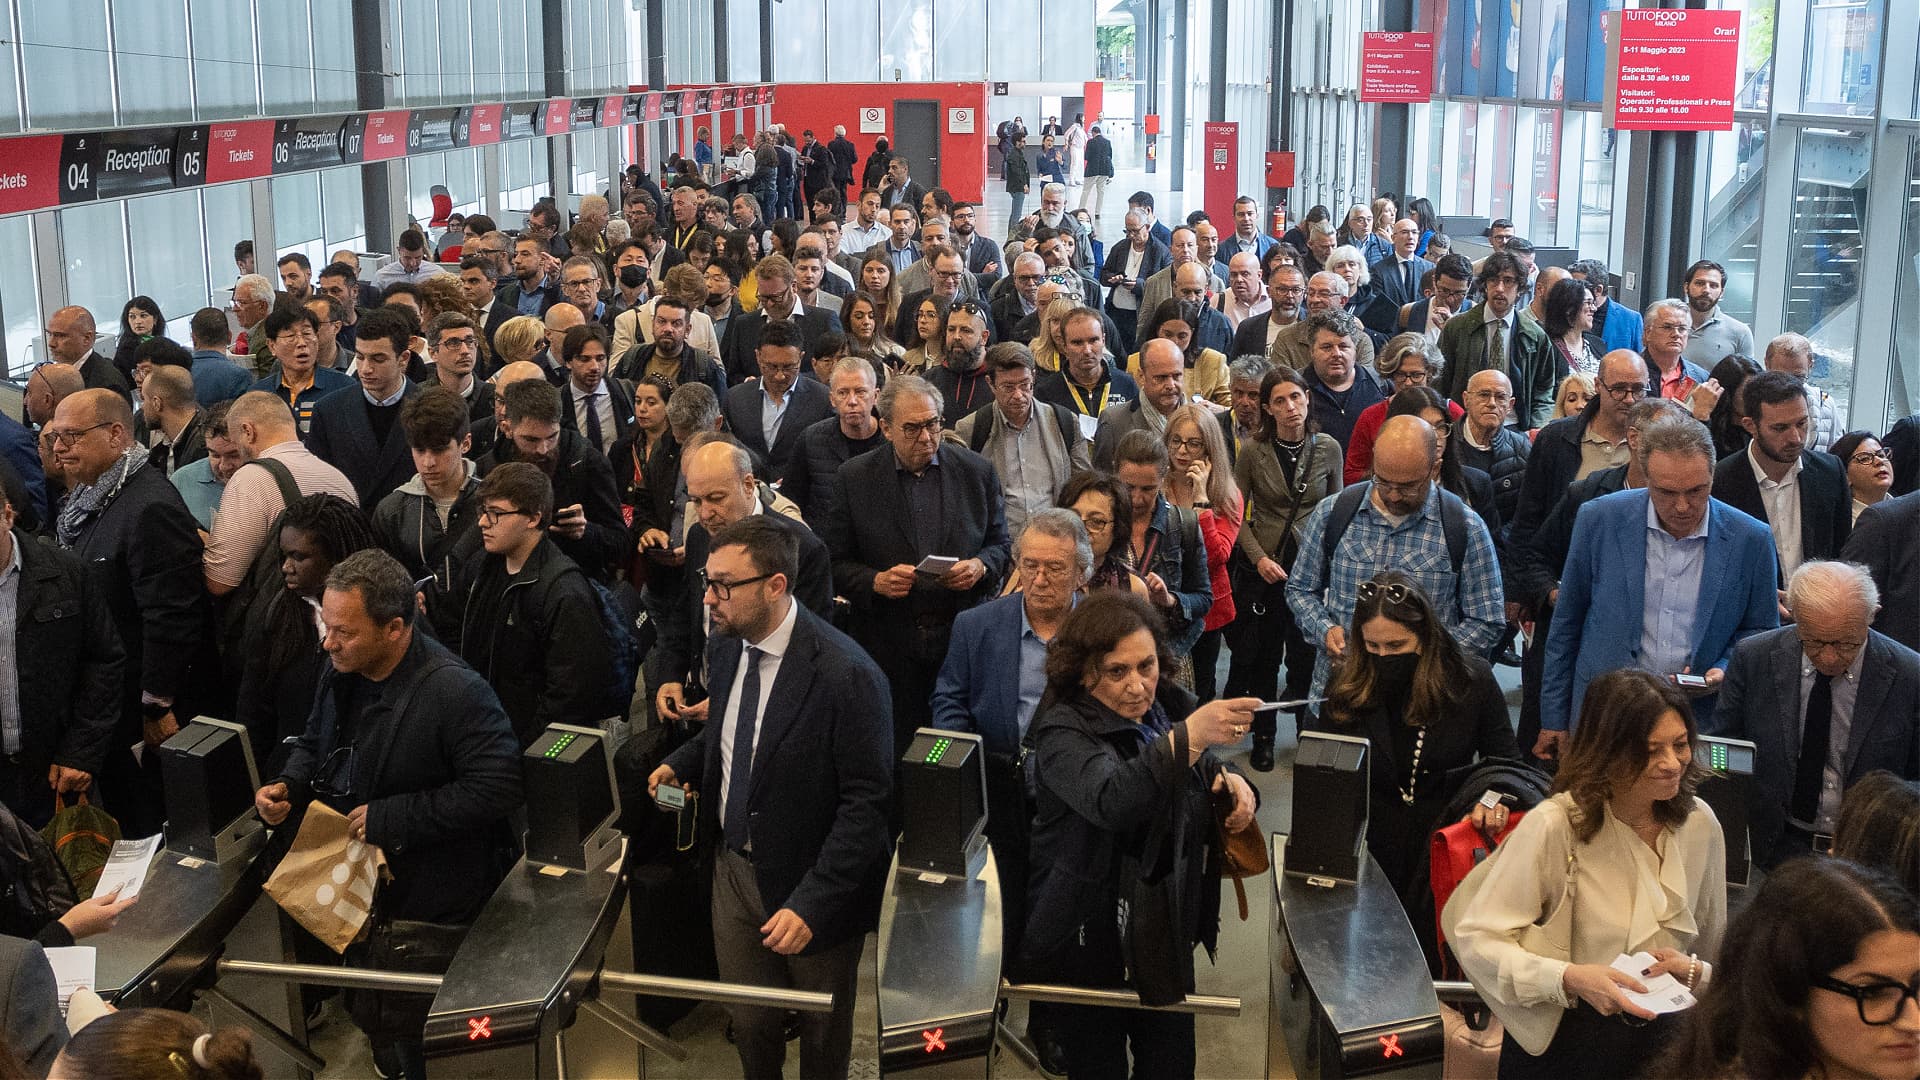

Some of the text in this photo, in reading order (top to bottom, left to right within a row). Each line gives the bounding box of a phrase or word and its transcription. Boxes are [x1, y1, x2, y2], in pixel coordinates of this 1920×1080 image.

[1625, 10, 1687, 21] TUTTOFOOD
[1713, 27, 1736, 36] Orari
[1640, 46, 1667, 54] Maggio
[1668, 46, 1686, 54] 2023
[1622, 66, 1662, 74] Espositori:
[1656, 98, 1703, 106] Professionali
[377, 133, 395, 144] Tickets
[410, 129, 420, 147] 08
[460, 124, 468, 140] 09
[296, 130, 338, 152] Reception
[349, 134, 360, 154] 07
[105, 146, 171, 172] Reception
[228, 149, 254, 162] Tickets
[275, 142, 288, 163] 06
[183, 152, 200, 176] 05
[68, 163, 89, 191] 04
